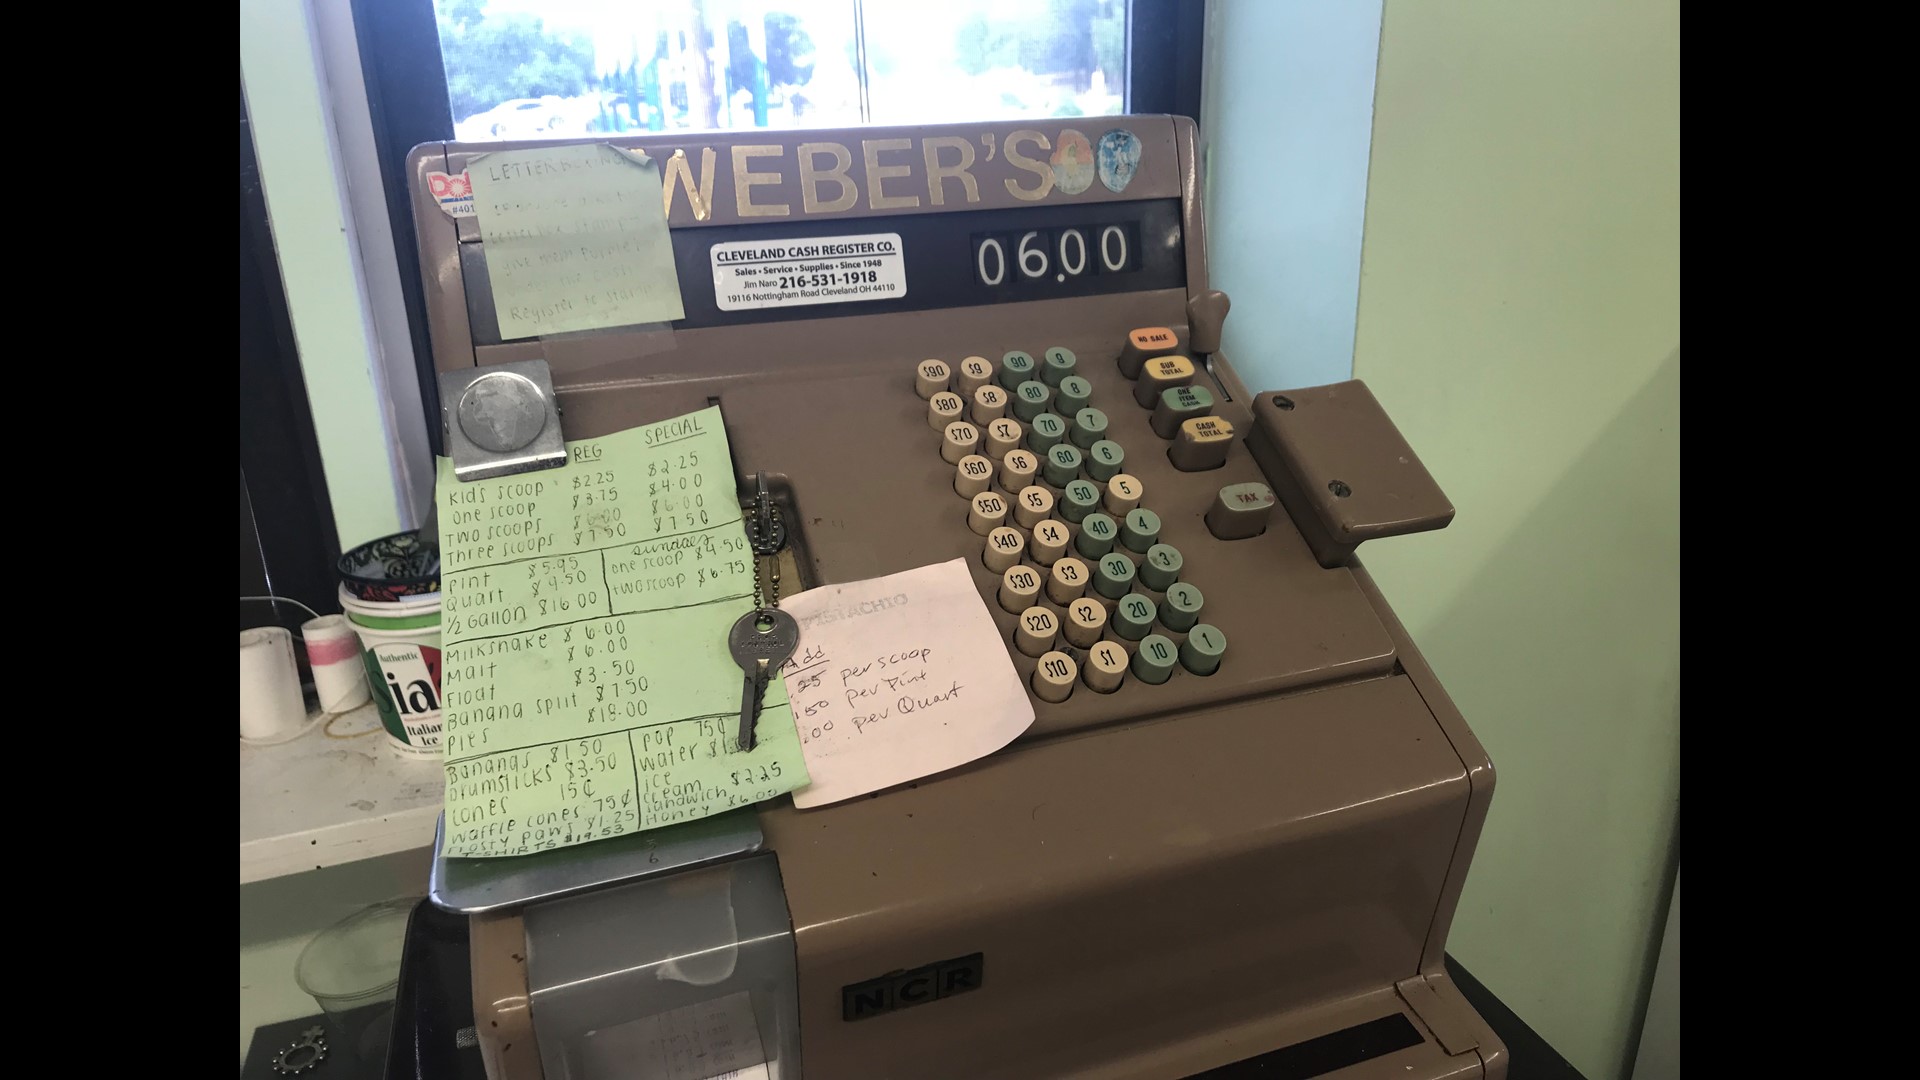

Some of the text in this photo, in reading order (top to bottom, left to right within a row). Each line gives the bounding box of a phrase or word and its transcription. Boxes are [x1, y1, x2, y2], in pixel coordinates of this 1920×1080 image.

[645, 130, 1054, 221] WEBER'S
[717, 241, 895, 262] CLEVELAND CASH REGISTER CO.
[735, 259, 882, 276] Sales Service Supplies Since 1948
[743, 271, 877, 289] Jim Naro 216-531-1918
[728, 283, 895, 303] 19116 Nottingham Road Cleveland OH 44110
[1138, 333, 1168, 343] NO SALE
[1010, 356, 1027, 368] 90
[1055, 353, 1065, 364] 9
[1160, 361, 1175, 369] SUB
[923, 364, 945, 377] $90
[968, 362, 983, 374] $9
[1160, 367, 1183, 376] TOTAL
[1025, 386, 1042, 398] 80
[1071, 382, 1080, 394] 8
[1177, 387, 1191, 395] ONE
[936, 397, 957, 411] $80
[982, 391, 997, 403] $8
[1178, 394, 1195, 402] ITEM
[1040, 419, 1058, 432] 70
[1086, 414, 1095, 427] 7
[1196, 421, 1216, 431] CASH
[951, 427, 973, 441] $70
[997, 424, 1010, 437] $7
[1199, 429, 1223, 438] TOTAL
[573, 416, 703, 462] REG SPECIAL
[1056, 450, 1074, 463] 60
[1101, 446, 1112, 460] 6
[964, 461, 987, 475] $60
[1012, 456, 1028, 469] $6
[498, 482, 544, 500] scoop
[1073, 486, 1091, 501] 50
[1119, 481, 1131, 495] 5
[978, 498, 1002, 513] $50
[1027, 492, 1043, 507] $5
[1235, 493, 1258, 503] TAX
[490, 502, 536, 520] scoop
[1092, 520, 1109, 534] 40
[1139, 516, 1149, 530] 4
[994, 533, 1018, 549] $40
[1042, 526, 1059, 541] $4
[643, 550, 684, 570] scoop
[1159, 552, 1170, 566] 3
[529, 556, 579, 579] $5.95
[1061, 565, 1078, 581] $3
[1107, 560, 1128, 576] 30
[1010, 572, 1035, 589] $30
[1178, 591, 1192, 606] 2
[801, 592, 908, 630] PISTACHIO
[1078, 606, 1097, 622] $2
[1127, 601, 1148, 618] 20
[1027, 613, 1052, 632] $20
[1202, 632, 1213, 649] 1
[378, 651, 419, 663] Authentic
[1100, 649, 1116, 667] $1
[1150, 642, 1168, 660] 10
[574, 659, 635, 687] $3.50
[840, 663, 872, 687] per
[878, 647, 931, 669] scoop
[1044, 659, 1068, 678] $10
[845, 685, 878, 709] per
[852, 708, 888, 734] per
[897, 680, 964, 714] Quart
[421, 736, 438, 746] Ice
[855, 967, 973, 1017] NCR
